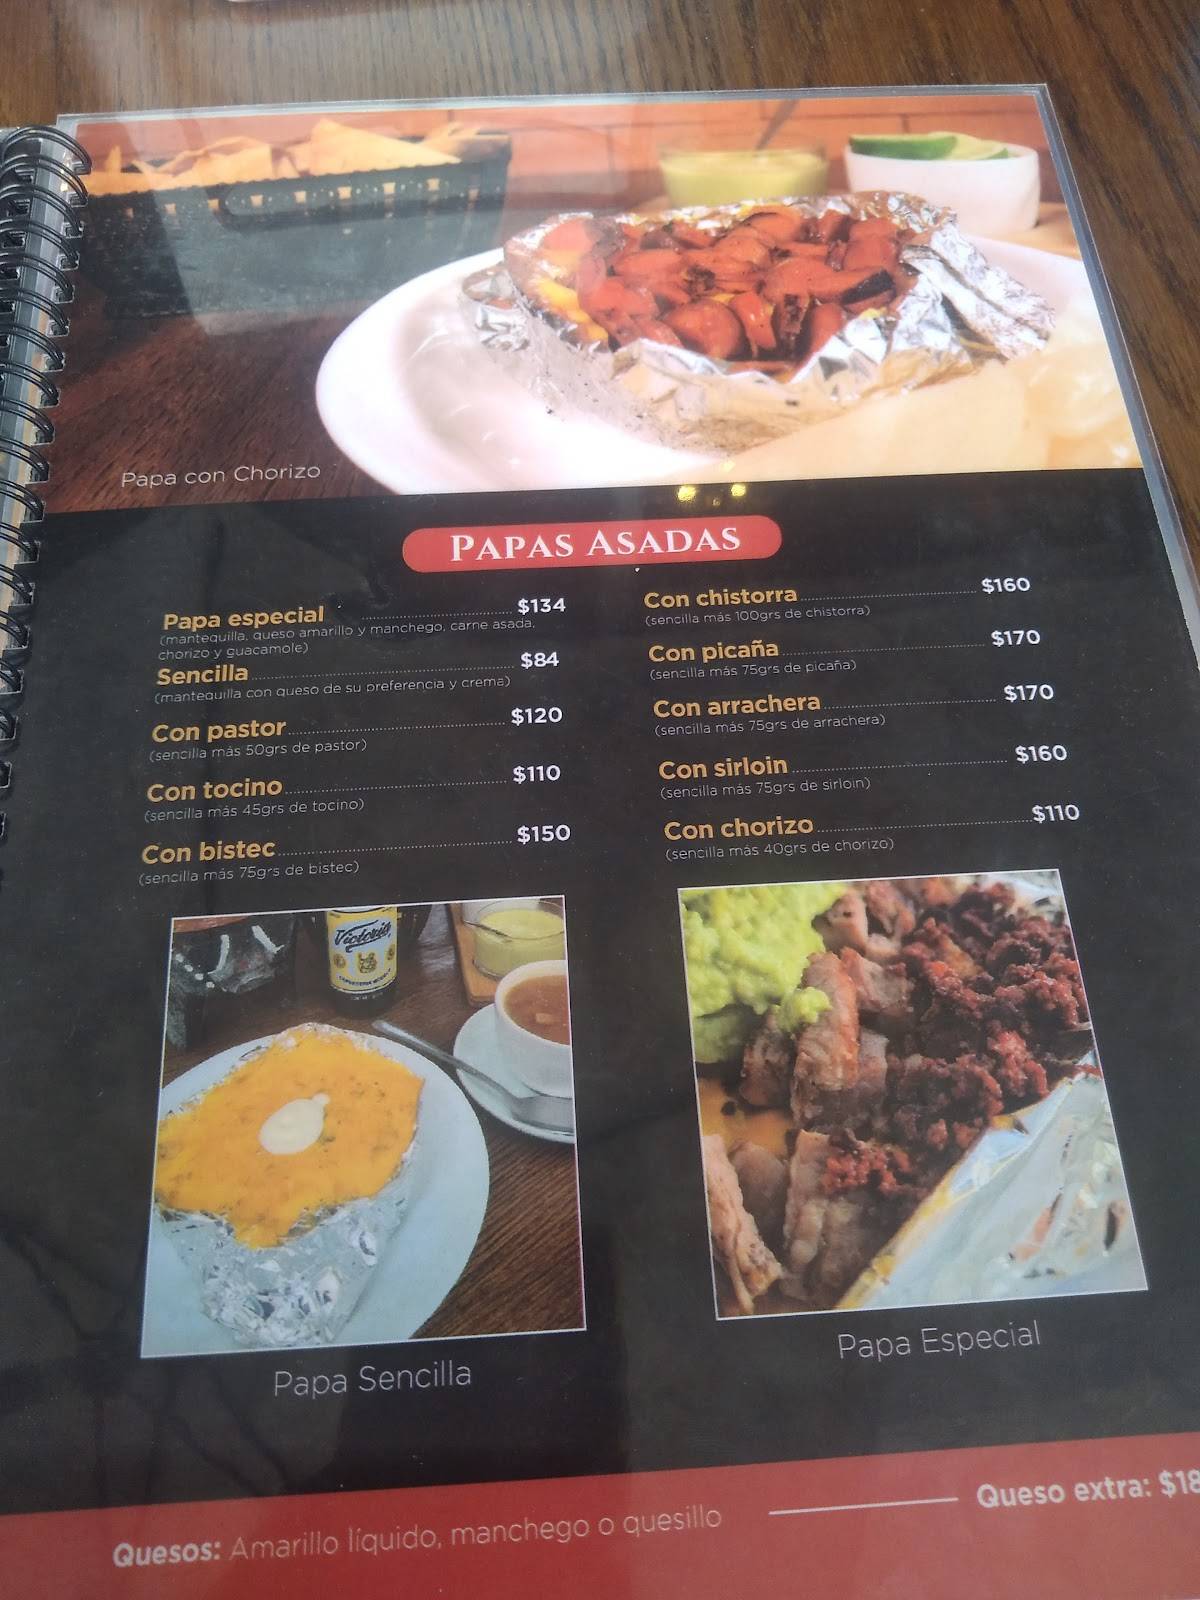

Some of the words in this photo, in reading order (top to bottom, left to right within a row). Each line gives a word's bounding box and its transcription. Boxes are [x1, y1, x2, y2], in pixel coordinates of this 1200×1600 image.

[121, 471, 176, 489] Papa
[185, 470, 225, 484] con
[234, 465, 321, 482] Chorizo
[644, 592, 690, 609] Con
[696, 588, 798, 606] chistorra
[981, 577, 1031, 594] $160
[163, 613, 221, 632] Papa
[228, 606, 325, 628] especial
[517, 598, 566, 615] $134
[645, 614, 700, 627] (sencilla
[703, 611, 732, 622] más
[735, 610, 781, 622] 100grs
[785, 606, 802, 618] de
[805, 604, 871, 618] chistorra)
[253, 629, 295, 643] queso
[299, 625, 354, 638] amarillo
[357, 626, 366, 636] y
[450, 621, 488, 631] carne
[648, 645, 695, 662] Con
[702, 639, 779, 663] picaña
[990, 629, 1041, 647] $170
[156, 664, 249, 685] Sencilla
[520, 651, 560, 669] $84
[158, 647, 210, 660] chorizo
[213, 649, 222, 660] y
[226, 643, 309, 658] guacamole)
[650, 667, 705, 681] (sencilla
[709, 665, 738, 676] más
[742, 664, 780, 676] 75grs
[784, 660, 801, 673] de
[805, 659, 857, 673] picaña)
[154, 688, 242, 704] (mantequilla
[246, 688, 272, 698] con
[276, 685, 320, 697] queso
[323, 683, 342, 694] de
[345, 684, 361, 693] su
[366, 679, 445, 694] preferencia
[449, 680, 458, 690] y
[461, 675, 511, 688] crema)
[653, 699, 701, 718] Con
[707, 694, 821, 716] arrachera
[1003, 684, 1054, 703] $170
[151, 722, 200, 743] Con
[207, 720, 287, 743] pastor
[511, 706, 563, 727] $120
[654, 722, 711, 737] (sencilla
[715, 720, 744, 733] más
[748, 719, 787, 733] 75grs
[791, 717, 810, 729] de
[813, 713, 886, 728] arrachera)
[149, 750, 207, 763] (sencilla
[211, 745, 241, 757] más
[245, 744, 288, 757] 50grs
[292, 741, 310, 753] de
[315, 738, 367, 754] pastor)
[658, 760, 708, 780] Con
[714, 755, 789, 778] sirloin
[1014, 744, 1068, 764] $160
[146, 783, 196, 803] Con
[202, 777, 283, 799] tocino
[512, 765, 561, 784] $110
[660, 785, 718, 800] (sencilla
[722, 782, 752, 795] más
[755, 782, 796, 795] 75grs
[800, 778, 818, 791] de
[822, 776, 871, 790] sirloin)
[144, 807, 203, 823] (sencilla
[208, 804, 238, 818] más
[242, 804, 284, 818] 45grs
[289, 801, 308, 813] de
[312, 798, 365, 812] tocino)
[664, 821, 714, 841] Con
[720, 815, 814, 838] chorizo
[1031, 803, 1080, 824] $110
[141, 845, 192, 864] Con
[199, 840, 276, 861] bistec
[517, 824, 571, 844] $150
[665, 847, 724, 862] (sencilla
[729, 843, 760, 857] más
[763, 843, 807, 857] 40grs
[811, 840, 830, 853] de
[834, 837, 894, 853] chorizo)
[138, 869, 199, 886] (sencilla
[203, 867, 234, 881] más
[239, 866, 280, 879] 75grs
[285, 863, 304, 876] de
[308, 860, 360, 875] bistec)
[838, 1333, 911, 1362] Papa
[920, 1319, 1041, 1357] Especial
[274, 1370, 348, 1400] Papa
[358, 1359, 472, 1392] Sencilla
[976, 1483, 1066, 1509] Queso
[1074, 1476, 1152, 1502] extra:
[1158, 1469, 1200, 1499] $18
[112, 1540, 221, 1569] Quesos:
[229, 1527, 338, 1561] Amarillo
[348, 1523, 443, 1554] líquido,
[450, 1516, 590, 1547] manchego
[599, 1517, 613, 1536] o
[621, 1504, 723, 1537] quesillo
